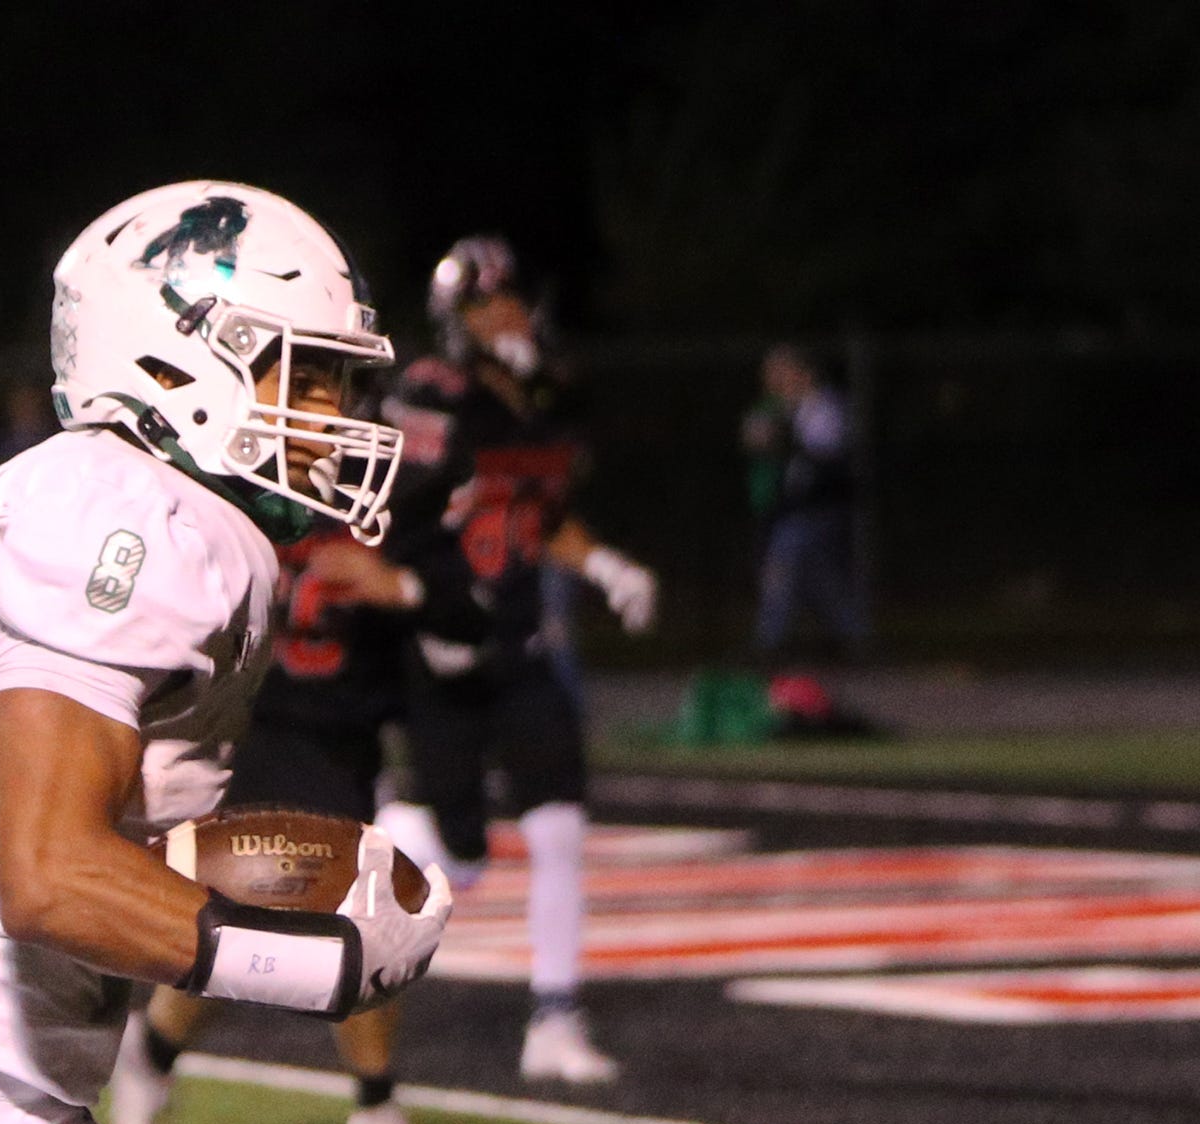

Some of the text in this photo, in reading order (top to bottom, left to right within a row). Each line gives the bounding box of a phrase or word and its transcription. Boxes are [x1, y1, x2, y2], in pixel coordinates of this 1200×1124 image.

[85, 528, 146, 613] 8
[231, 834, 334, 858] Wilson
[247, 953, 276, 975] RB
